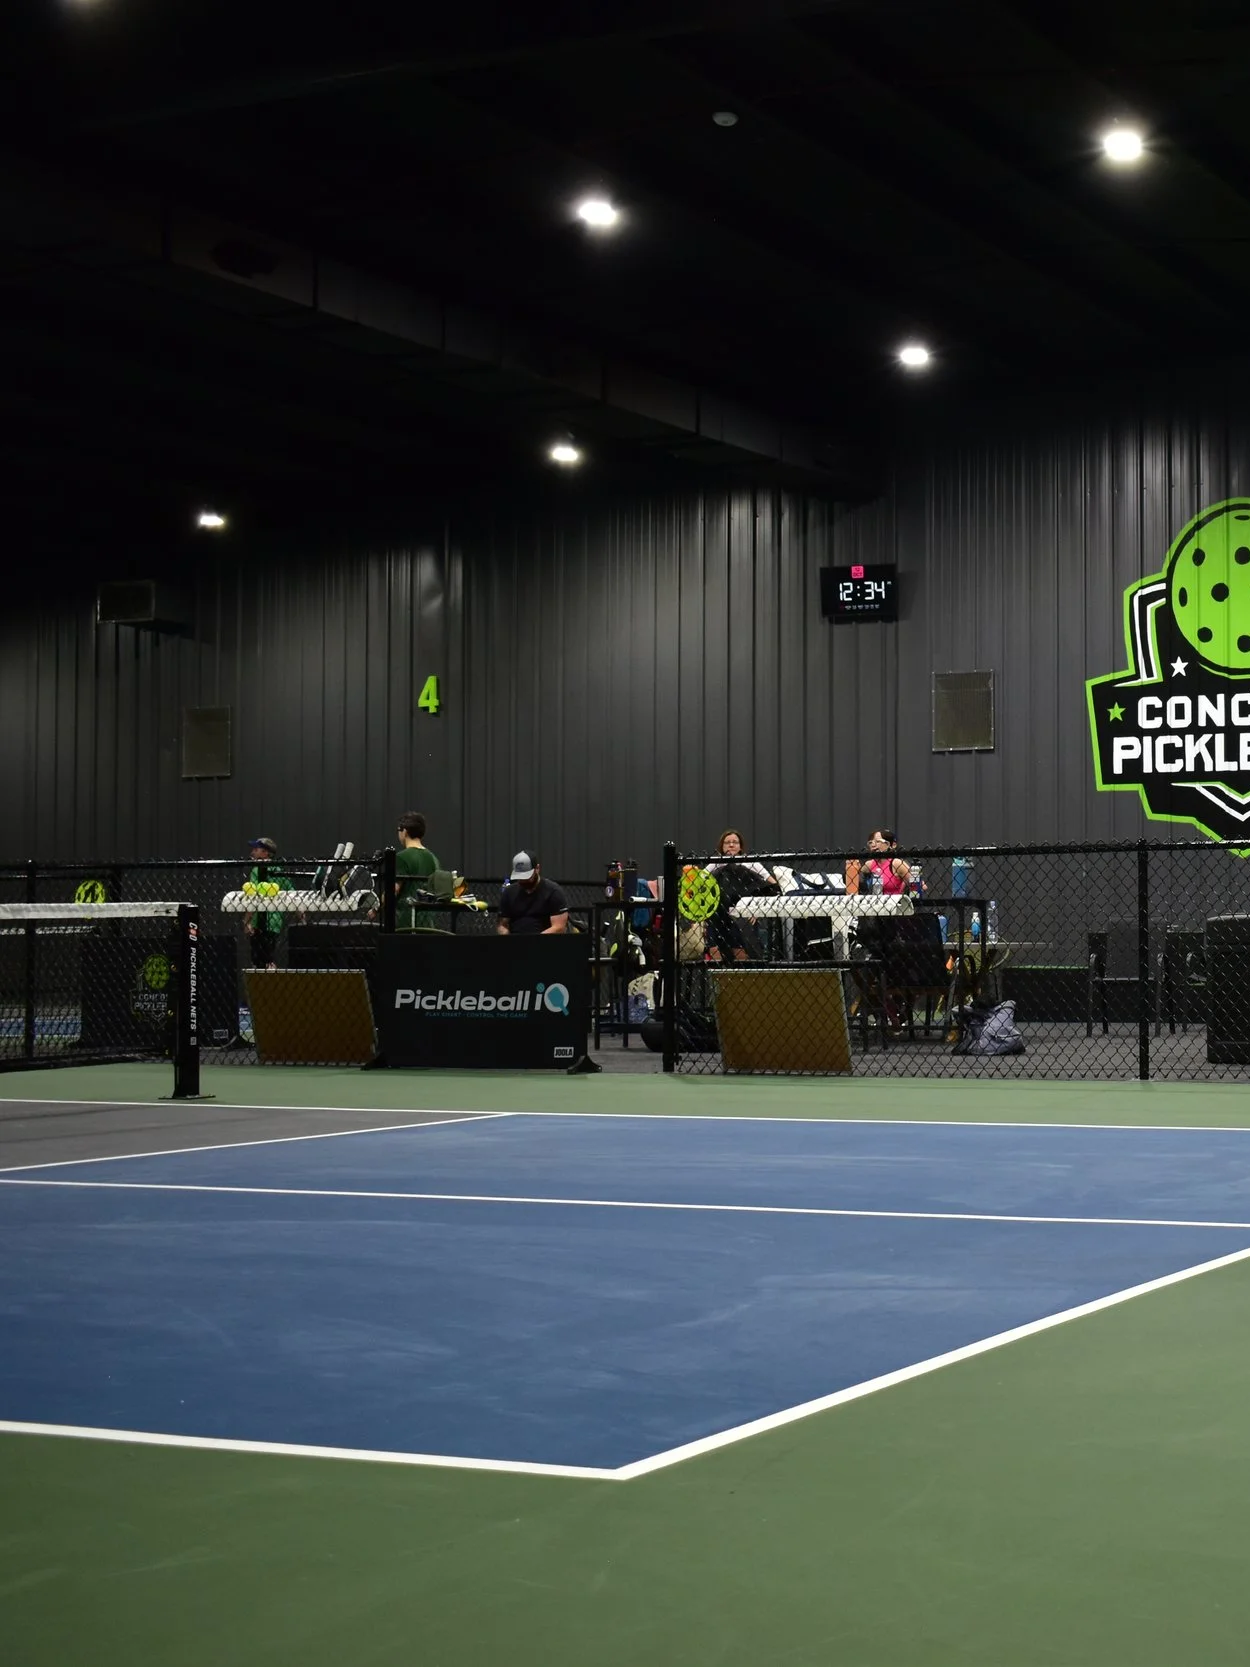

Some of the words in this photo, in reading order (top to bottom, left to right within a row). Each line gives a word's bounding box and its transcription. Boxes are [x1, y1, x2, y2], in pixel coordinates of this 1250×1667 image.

[839, 581, 885, 601] 12:34
[418, 675, 439, 713] 4
[395, 989, 531, 1011] Pickleball
[534, 982, 570, 1016] iQ
[554, 1048, 573, 1057] JOOLA
